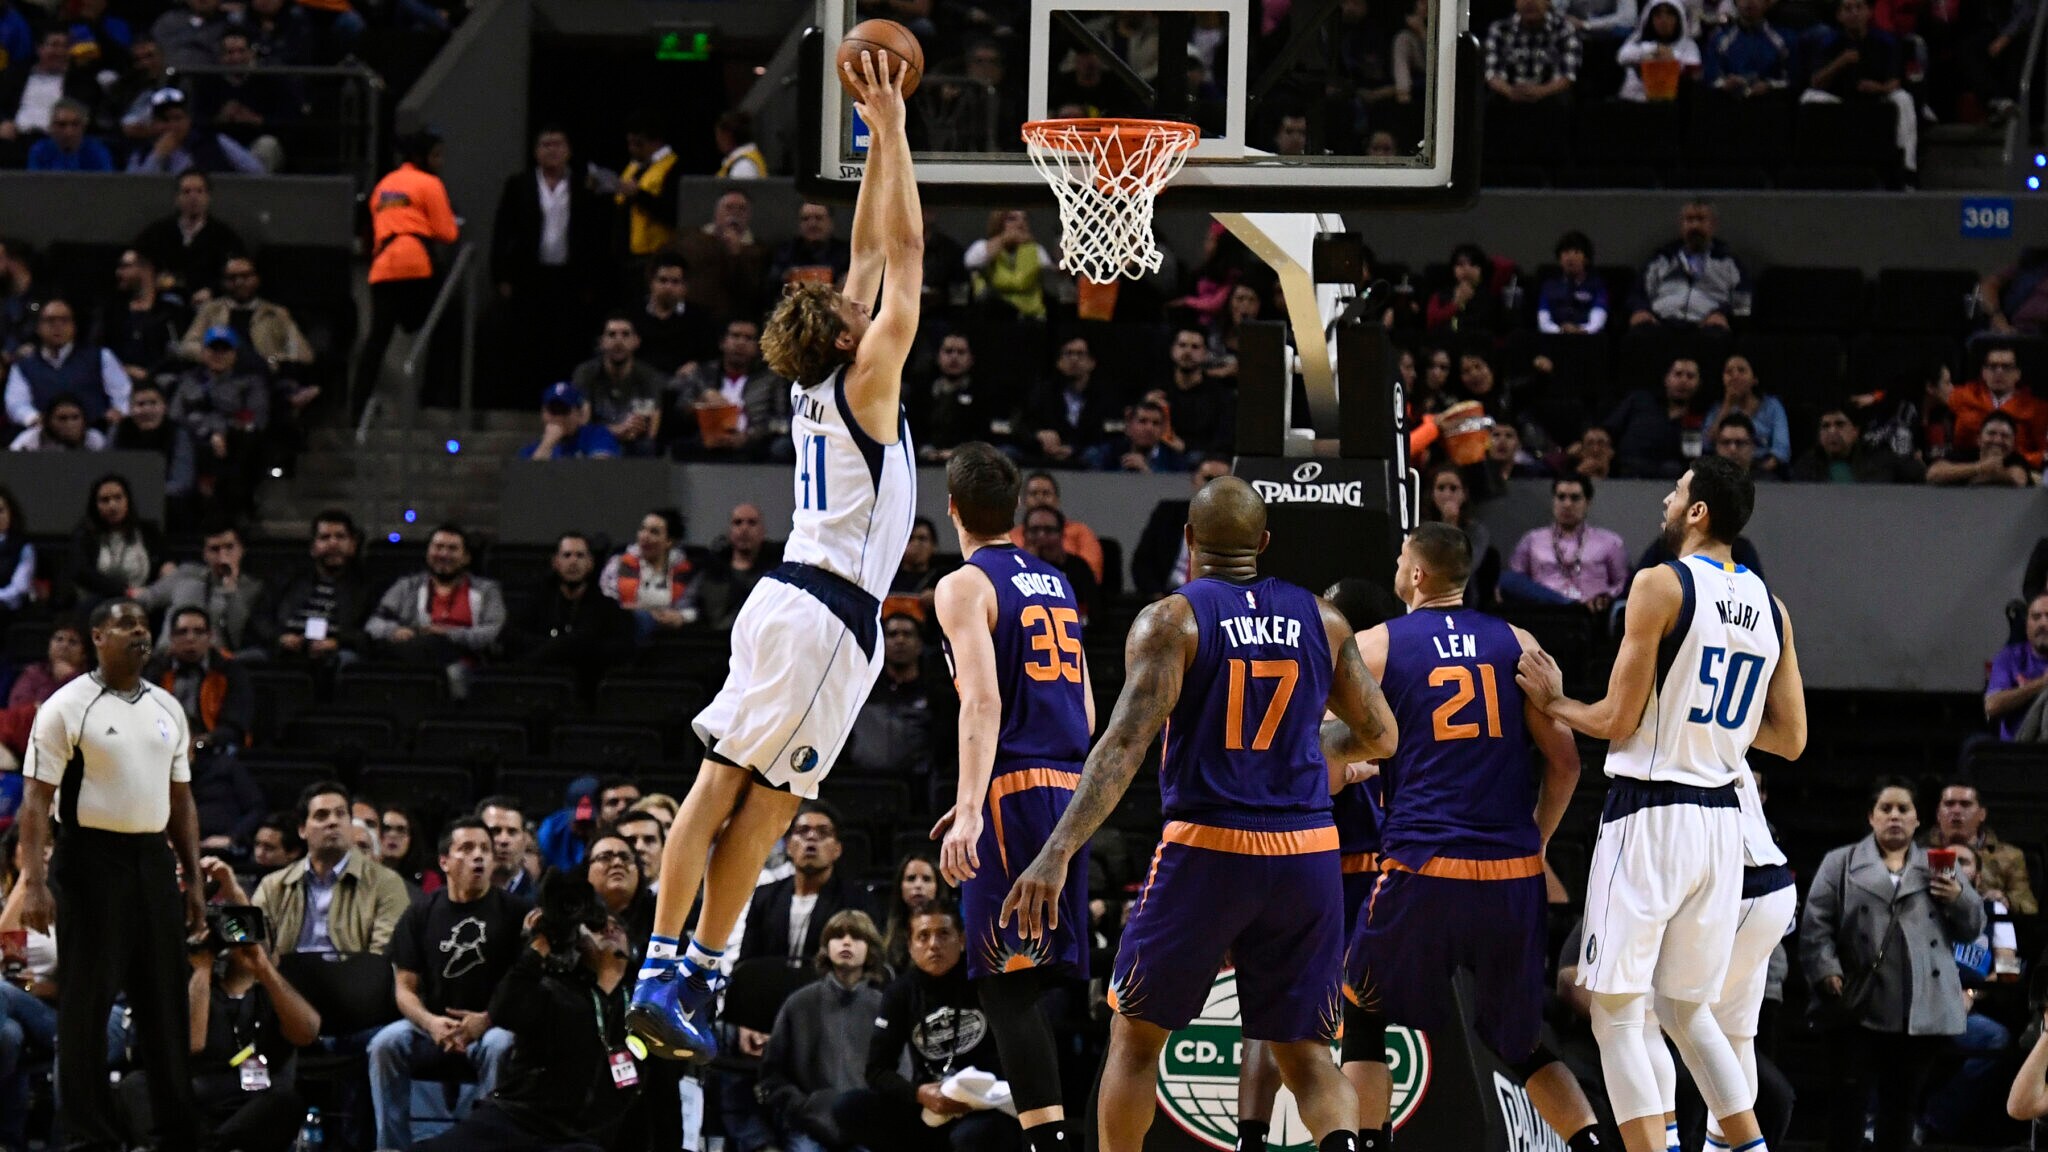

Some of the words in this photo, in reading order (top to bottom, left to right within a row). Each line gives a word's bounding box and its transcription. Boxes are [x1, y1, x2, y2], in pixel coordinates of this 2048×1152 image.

[1964, 207, 2010, 229] 308
[801, 434, 827, 511] 41
[1252, 479, 1362, 507] SPALDING
[1011, 572, 1066, 599] BENDER
[1220, 615, 1301, 648] TUCKER
[1715, 600, 1760, 632] MEJRI
[1020, 604, 1082, 683] 35
[1433, 634, 1476, 659] LEN
[1225, 658, 1299, 750] 17
[1428, 664, 1503, 741] 21
[1688, 646, 1766, 730] 50
[1174, 1040, 1225, 1064] CD.
